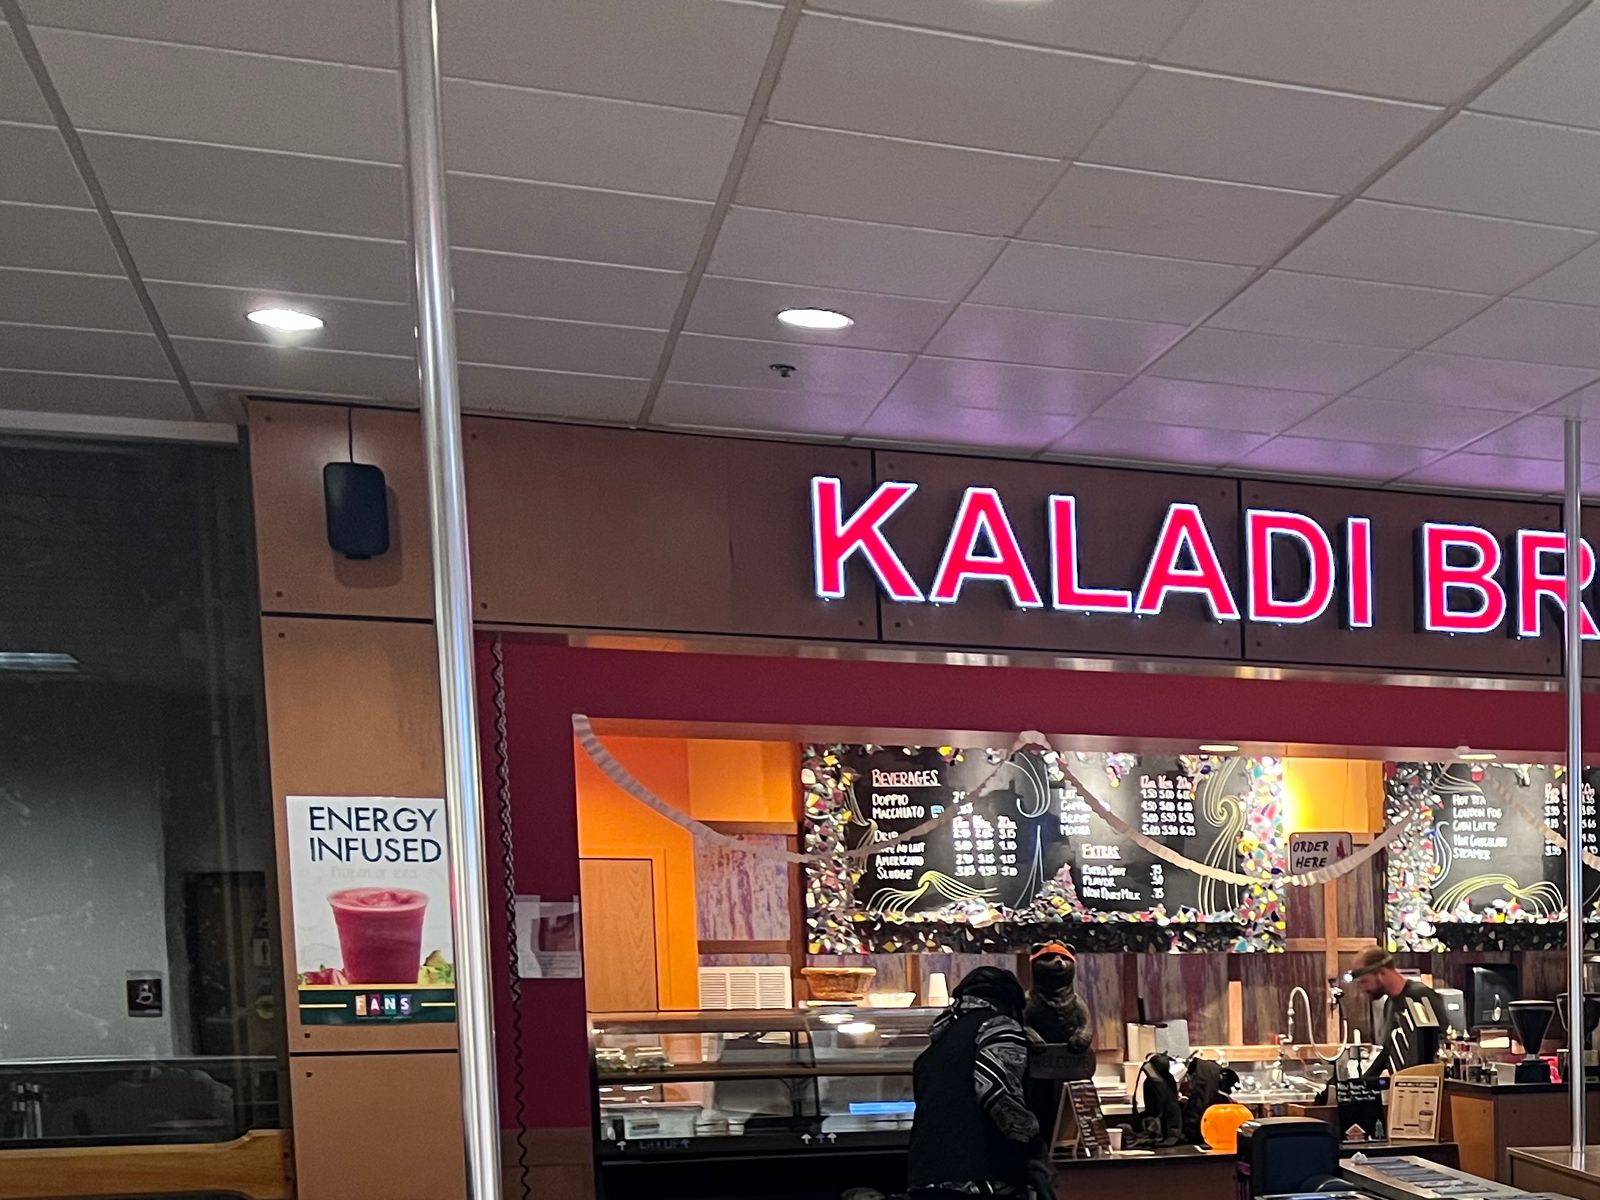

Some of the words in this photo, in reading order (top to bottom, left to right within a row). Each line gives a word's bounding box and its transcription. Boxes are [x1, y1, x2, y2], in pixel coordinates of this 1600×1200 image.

[811, 476, 1373, 628] KALADI
[872, 769, 940, 786] BEVERAGES
[872, 793, 909, 806] DOPPIO
[309, 806, 439, 832] ENERGY
[309, 837, 442, 863] INFUSED
[1081, 843, 1121, 859] EXTRAS
[1292, 840, 1329, 853] ORDER
[1295, 856, 1327, 869] HERE
